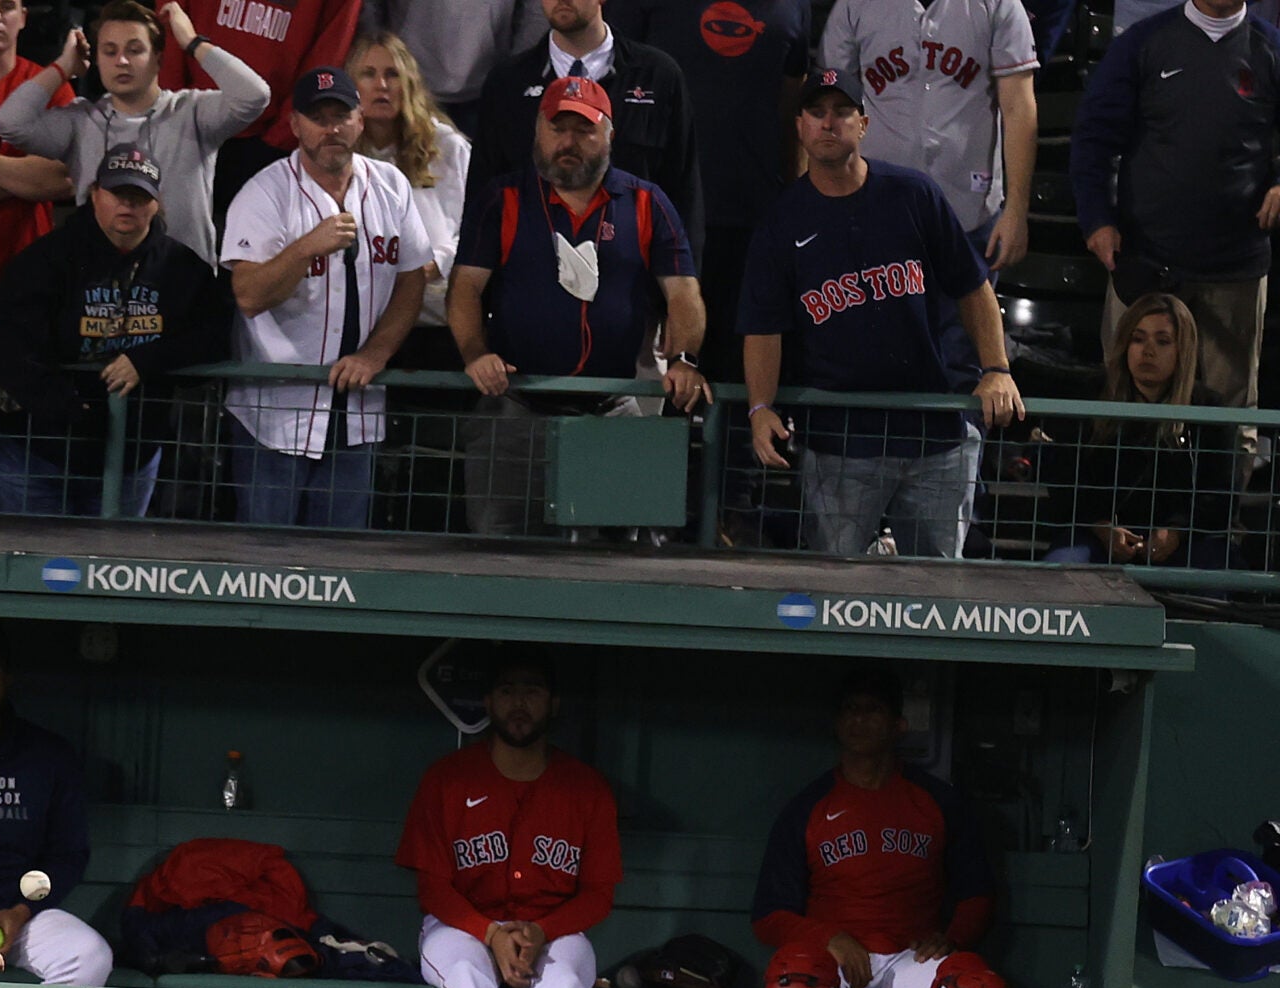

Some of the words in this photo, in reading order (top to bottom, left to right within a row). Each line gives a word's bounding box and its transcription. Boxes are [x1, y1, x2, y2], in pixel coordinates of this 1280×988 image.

[864, 40, 982, 96] BOSTON
[108, 160, 159, 181] CHAMPS
[85, 286, 160, 304] INVOVES
[800, 259, 926, 325] BOSTON
[87, 563, 212, 596] KONICA
[217, 570, 357, 603] MINOLTA
[822, 599, 947, 631] KONICA
[952, 604, 1091, 637] MINOLTA
[453, 831, 510, 871] RED
[532, 835, 582, 876] SOX
[820, 829, 869, 867] RED
[881, 828, 933, 860] SOX
